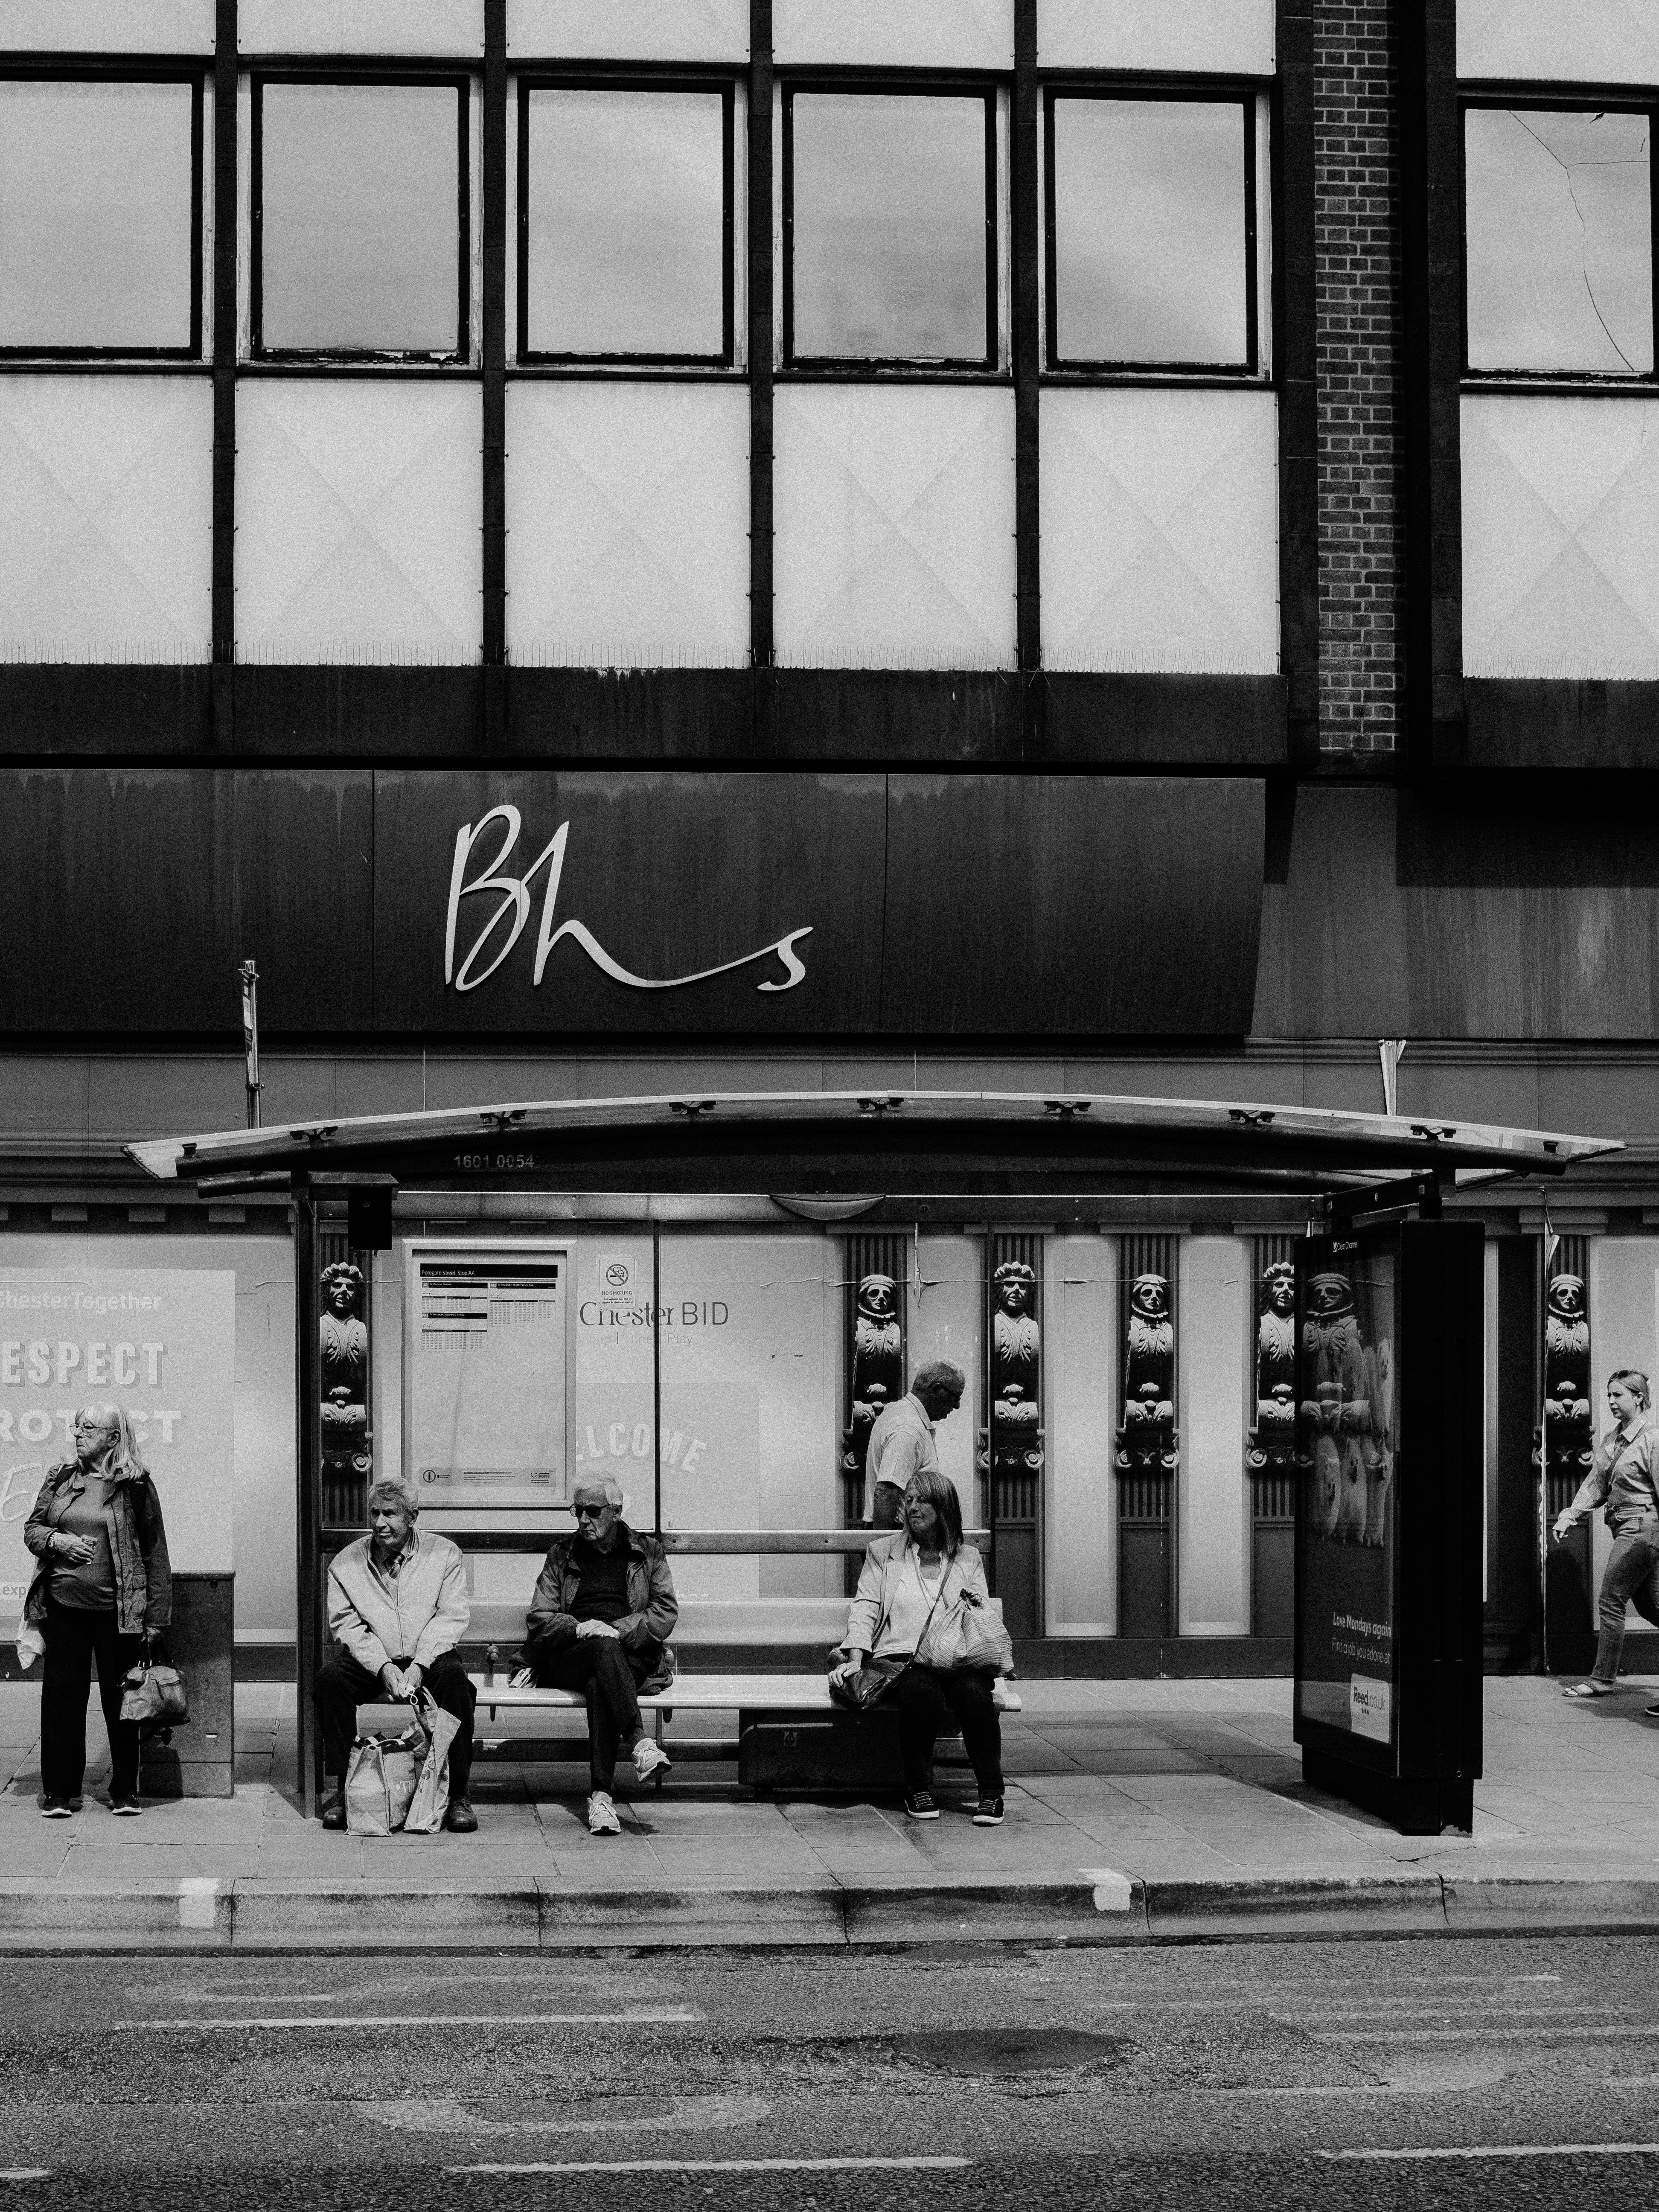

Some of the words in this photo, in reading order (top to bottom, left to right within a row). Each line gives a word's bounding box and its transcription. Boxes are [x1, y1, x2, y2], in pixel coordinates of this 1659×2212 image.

[445, 804, 813, 991] Bhs
[454, 1155, 489, 1168] 1601
[497, 1155, 534, 1168] 0054
[580, 1301, 675, 1327] Chester
[682, 1301, 728, 1325] BID
[626, 1333, 653, 1344] Dine
[667, 1332, 693, 1346] Play
[1333, 1612, 1345, 1627] Love
[1347, 1615, 1371, 1636] Mondays
[1373, 1621, 1391, 1639] again
[1332, 1637, 1342, 1653] Find
[1344, 1644, 1348, 1654] a
[1348, 1642, 1356, 1658] job
[1356, 1647, 1366, 1660] you
[1367, 1646, 1383, 1662] adore
[1384, 1651, 1391, 1664] at
